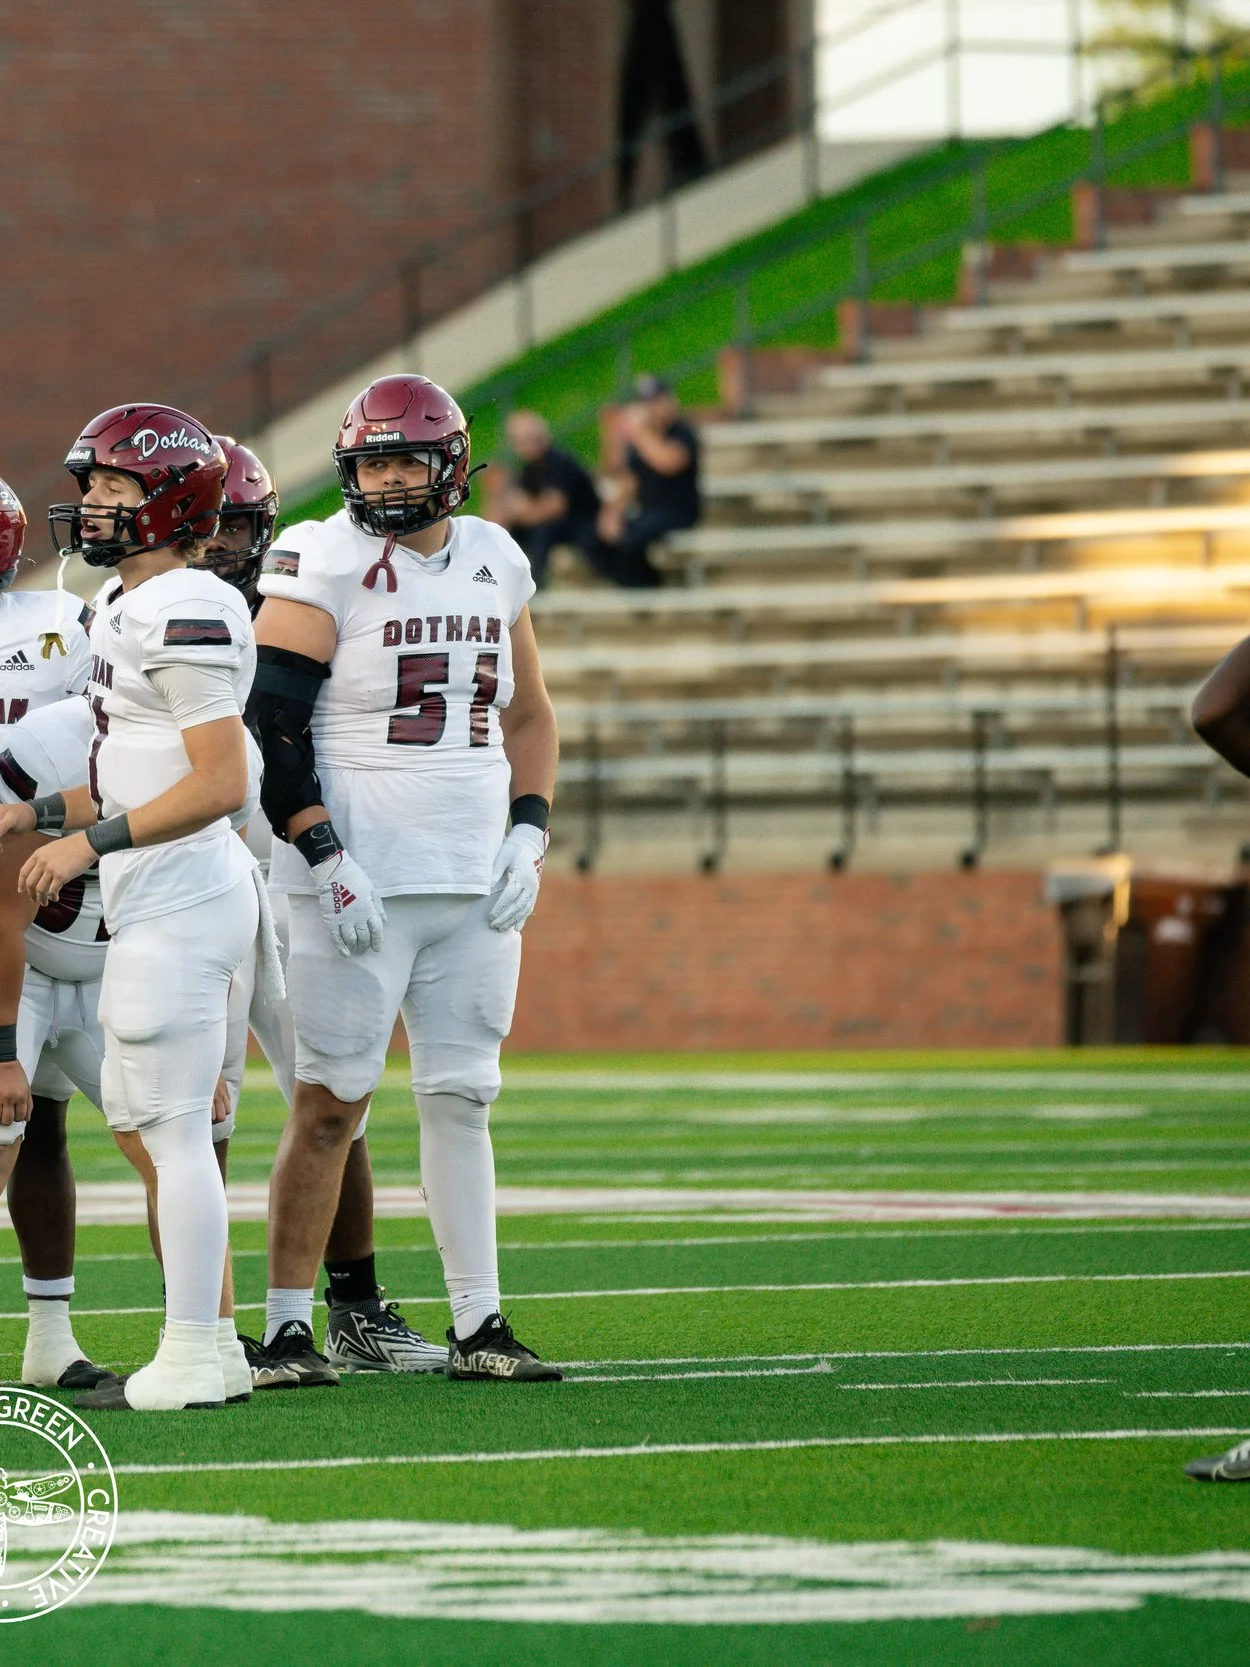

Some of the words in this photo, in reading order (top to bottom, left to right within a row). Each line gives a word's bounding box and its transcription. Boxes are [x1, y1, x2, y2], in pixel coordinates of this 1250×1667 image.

[133, 427, 212, 458] Dothan
[366, 432, 400, 443] Riddell
[472, 575, 499, 586] adidas
[383, 615, 502, 648] DOTHAN
[0, 662, 35, 671] adidas
[387, 652, 499, 748] 51
[331, 881, 342, 914] adidas
